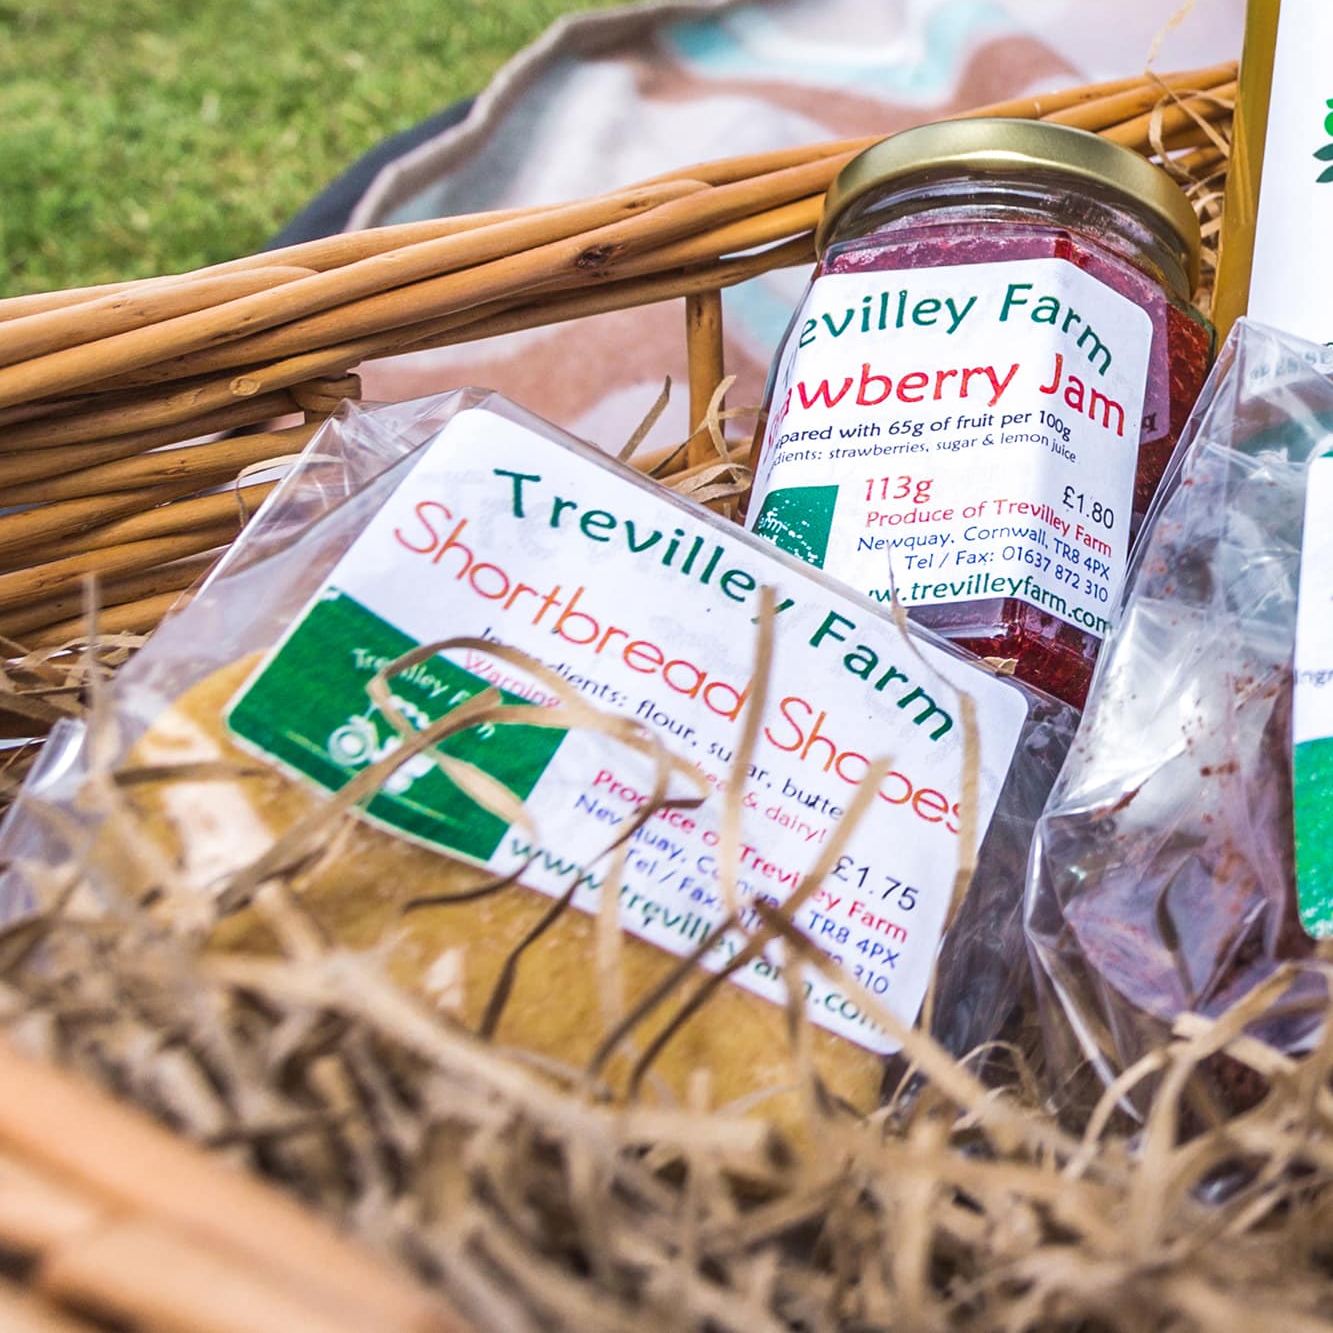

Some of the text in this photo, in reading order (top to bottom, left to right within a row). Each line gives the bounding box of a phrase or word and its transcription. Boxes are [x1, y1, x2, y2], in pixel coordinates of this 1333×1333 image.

[799, 283, 1113, 376] evilley Farm
[1040, 353, 1125, 436] Jam
[774, 432, 1077, 466] dients: strawberries, sugar & lemon juice
[839, 422, 881, 439] with
[888, 419, 925, 436] 65g
[930, 416, 952, 432] of
[955, 413, 994, 430] fruit
[1001, 411, 1032, 429] per
[1039, 410, 1072, 443] 100g
[864, 476, 934, 504] 113g
[1062, 486, 1115, 530] £1.80
[865, 499, 1112, 558] Produce of Trevilley Farm
[904, 545, 1108, 603] Tel / Fax: 01637 872 310
[1054, 539, 1080, 564] TR8
[1083, 556, 1111, 580] 4PX
[394, 501, 750, 723] Shortbread
[868, 572, 1112, 634] w.trevilleyfarm.com
[808, 608, 956, 743] Farm
[708, 741, 771, 788] suar,
[782, 778, 844, 820] butte
[765, 804, 828, 844] dairy!
[624, 848, 658, 876] Tel
[831, 855, 919, 912] £1.75
[739, 844, 841, 912] Treviey
[848, 900, 908, 944] Farm
[809, 909, 850, 945] TR8
[856, 938, 900, 969] 4PX
